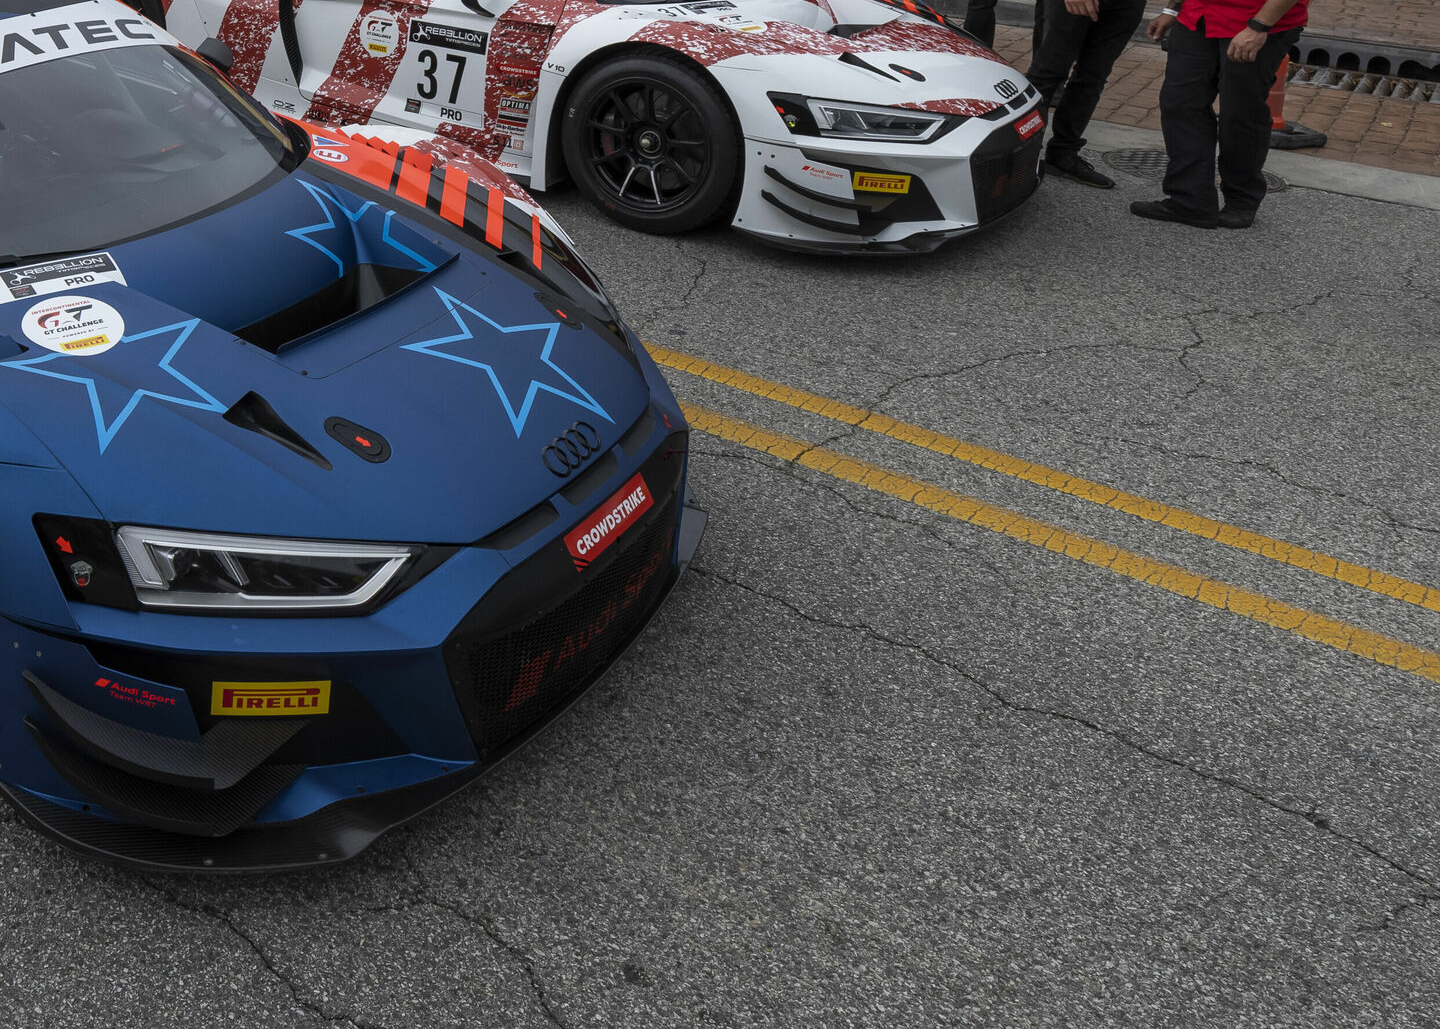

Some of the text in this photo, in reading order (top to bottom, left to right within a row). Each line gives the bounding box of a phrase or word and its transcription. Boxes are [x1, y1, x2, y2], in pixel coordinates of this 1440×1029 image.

[424, 26, 483, 43] REBELLION
[417, 49, 467, 105] 37
[500, 65, 537, 75] CROWDSTRIKE
[501, 100, 531, 110] OPTIMA
[440, 107, 463, 121] PRO
[497, 159, 519, 169] Sport
[825, 170, 844, 179] Sport
[858, 176, 906, 190] PIRELLI
[30, 256, 104, 277] REBELLION
[64, 273, 95, 288] PRO
[31, 299, 91, 315] INTERCONTINENTAL
[44, 318, 104, 335] GT CHALLENGE
[63, 336, 106, 350] PIRELLI
[576, 485, 647, 555] CROWDSTRIKE
[110, 682, 176, 706] Audi Sport
[222, 688, 321, 710] PIRELLI
